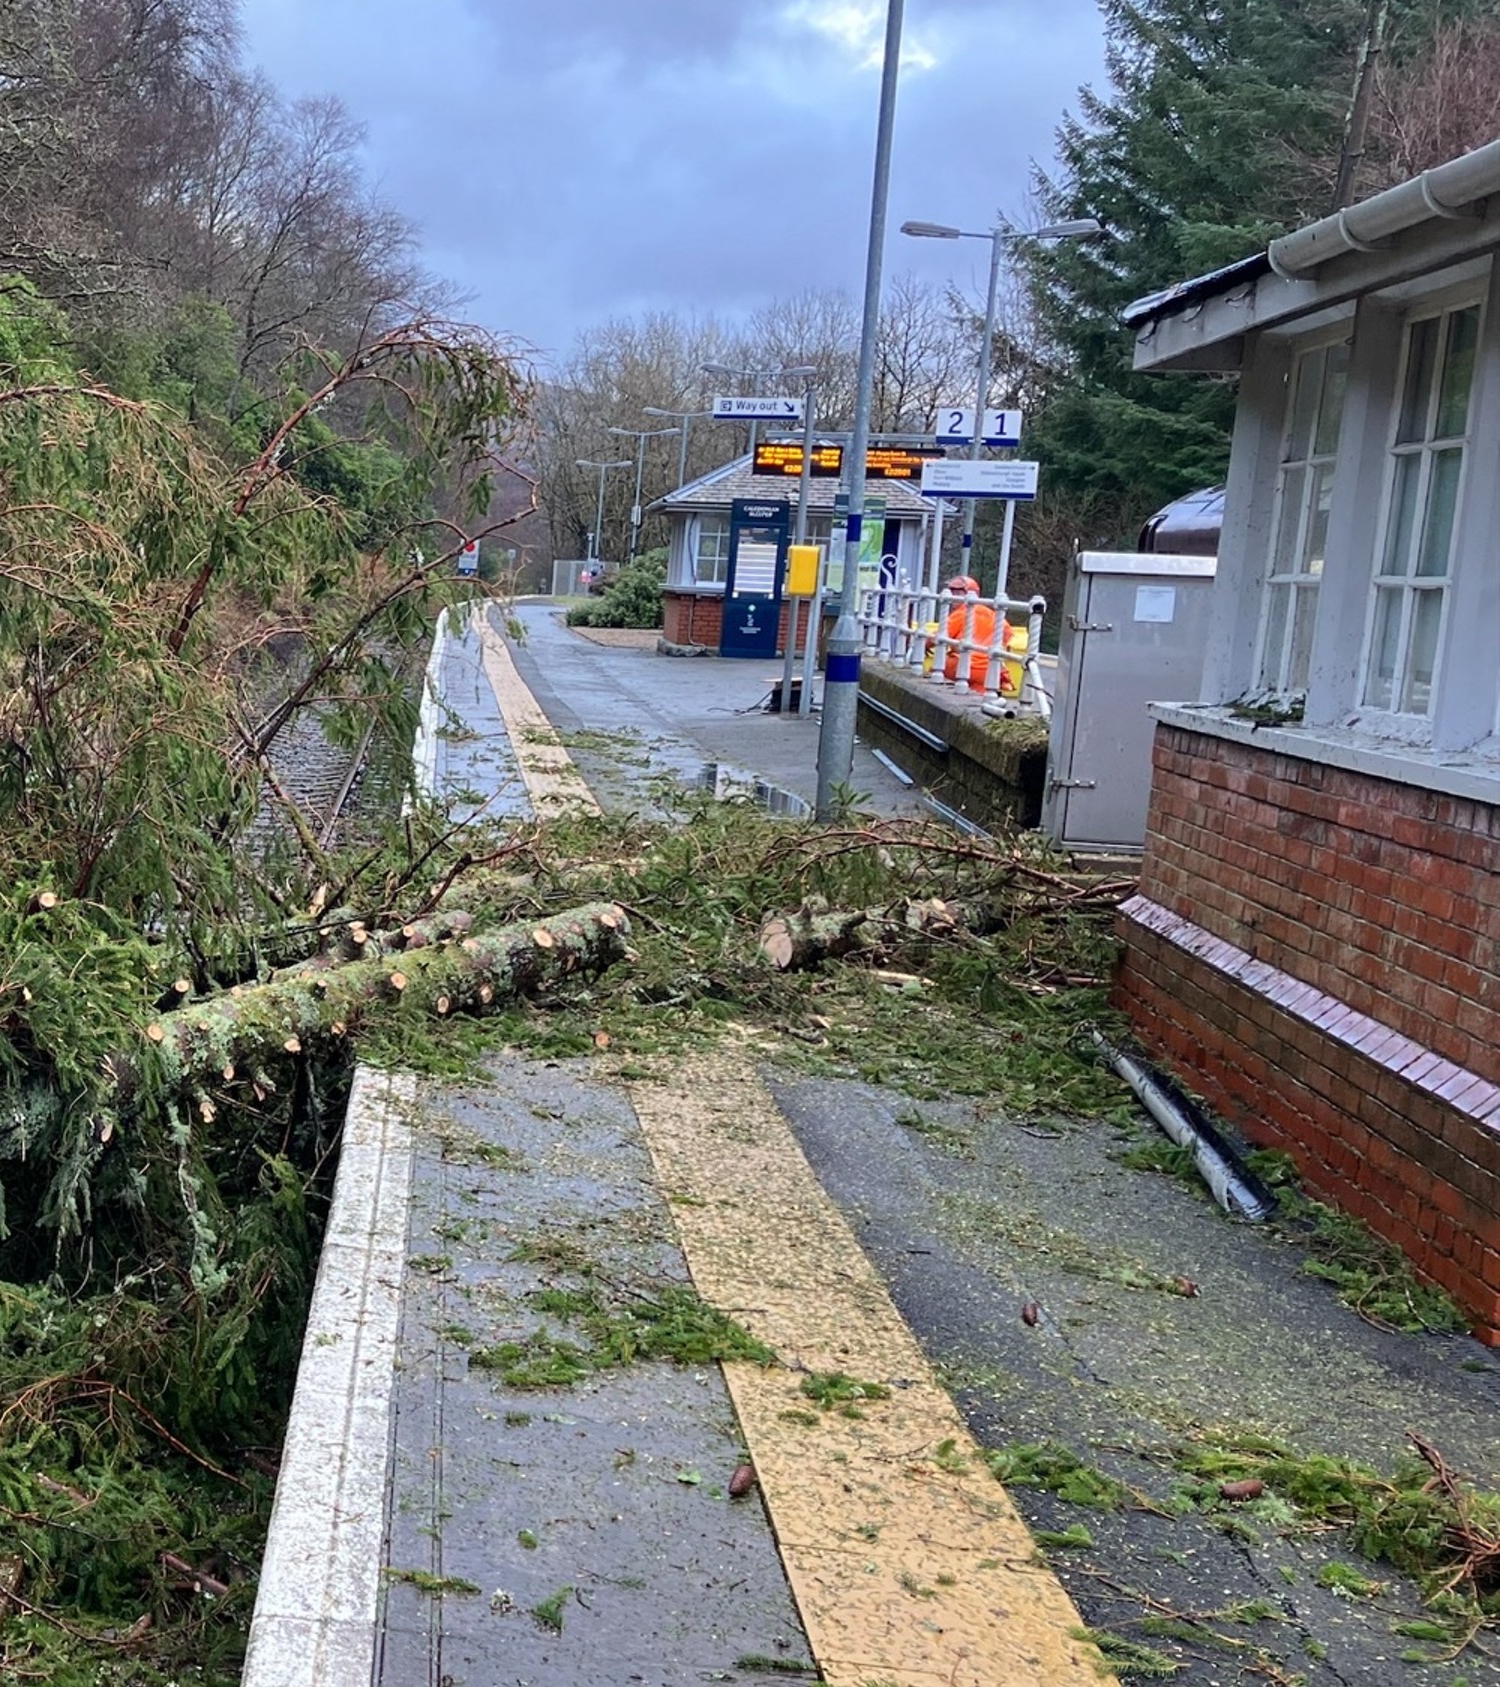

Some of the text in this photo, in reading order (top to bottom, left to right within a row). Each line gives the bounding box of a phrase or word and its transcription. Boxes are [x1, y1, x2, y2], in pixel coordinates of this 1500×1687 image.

[736, 400, 777, 413] Way out
[948, 411, 964, 434] 2
[994, 413, 1007, 435] 1
